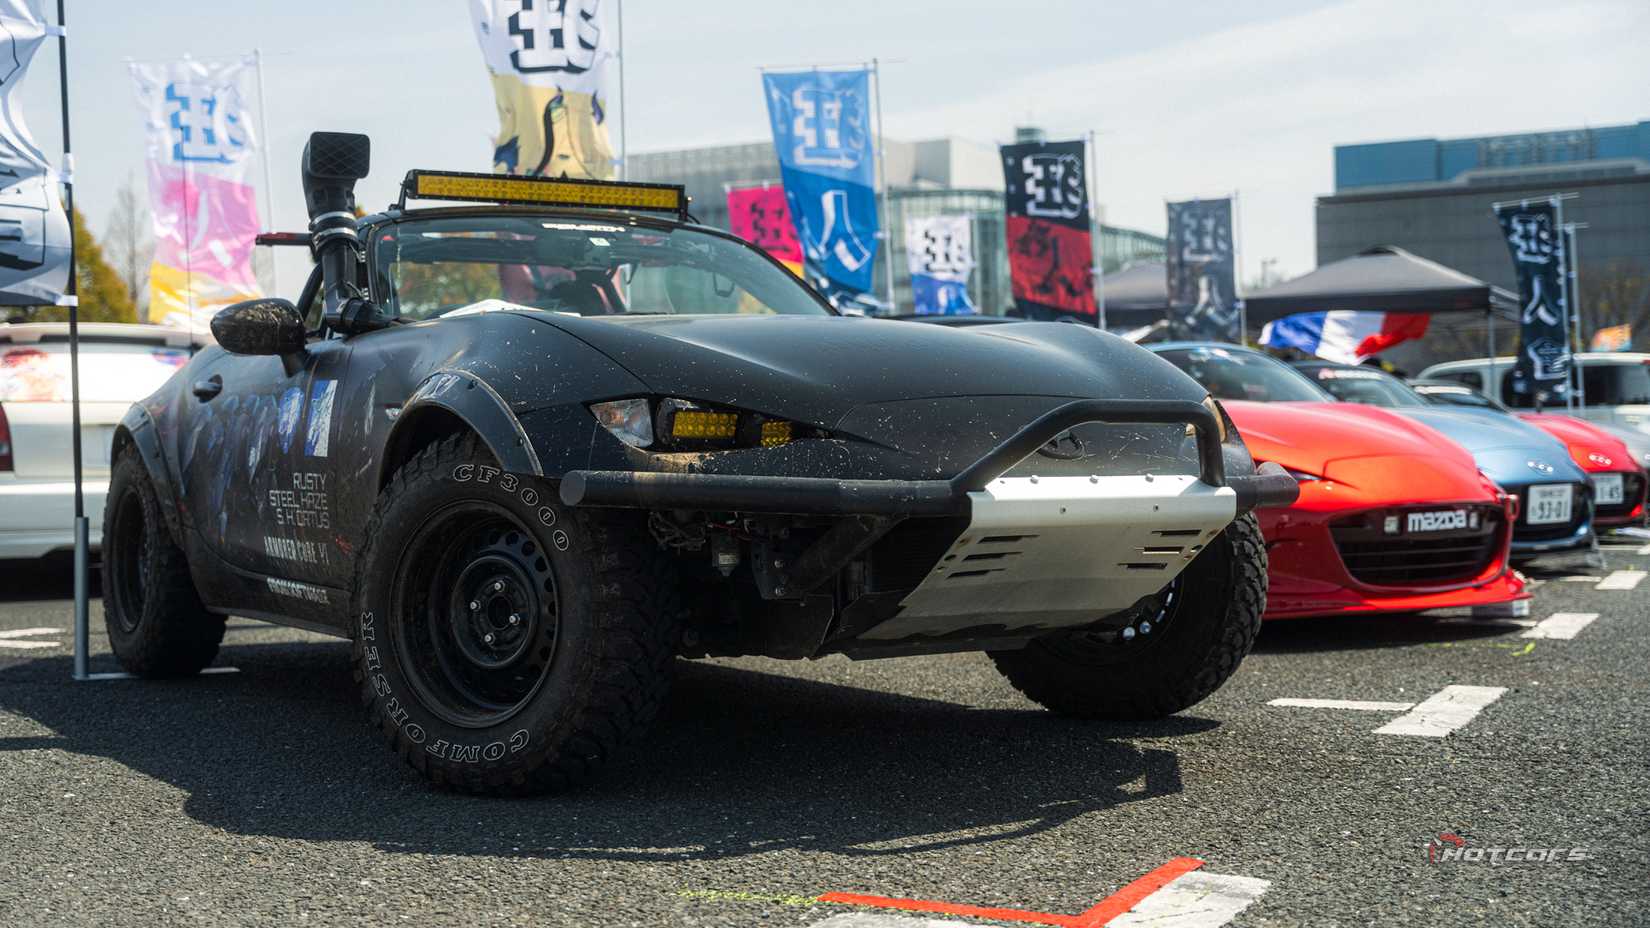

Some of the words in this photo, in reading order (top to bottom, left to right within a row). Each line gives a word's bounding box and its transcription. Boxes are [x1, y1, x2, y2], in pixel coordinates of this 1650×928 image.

[269, 489, 300, 507] STEEL
[300, 493, 329, 511] HAZE
[293, 472, 327, 491] RUSTY
[452, 464, 569, 551] CF3000
[361, 611, 530, 763] COMFORSER
